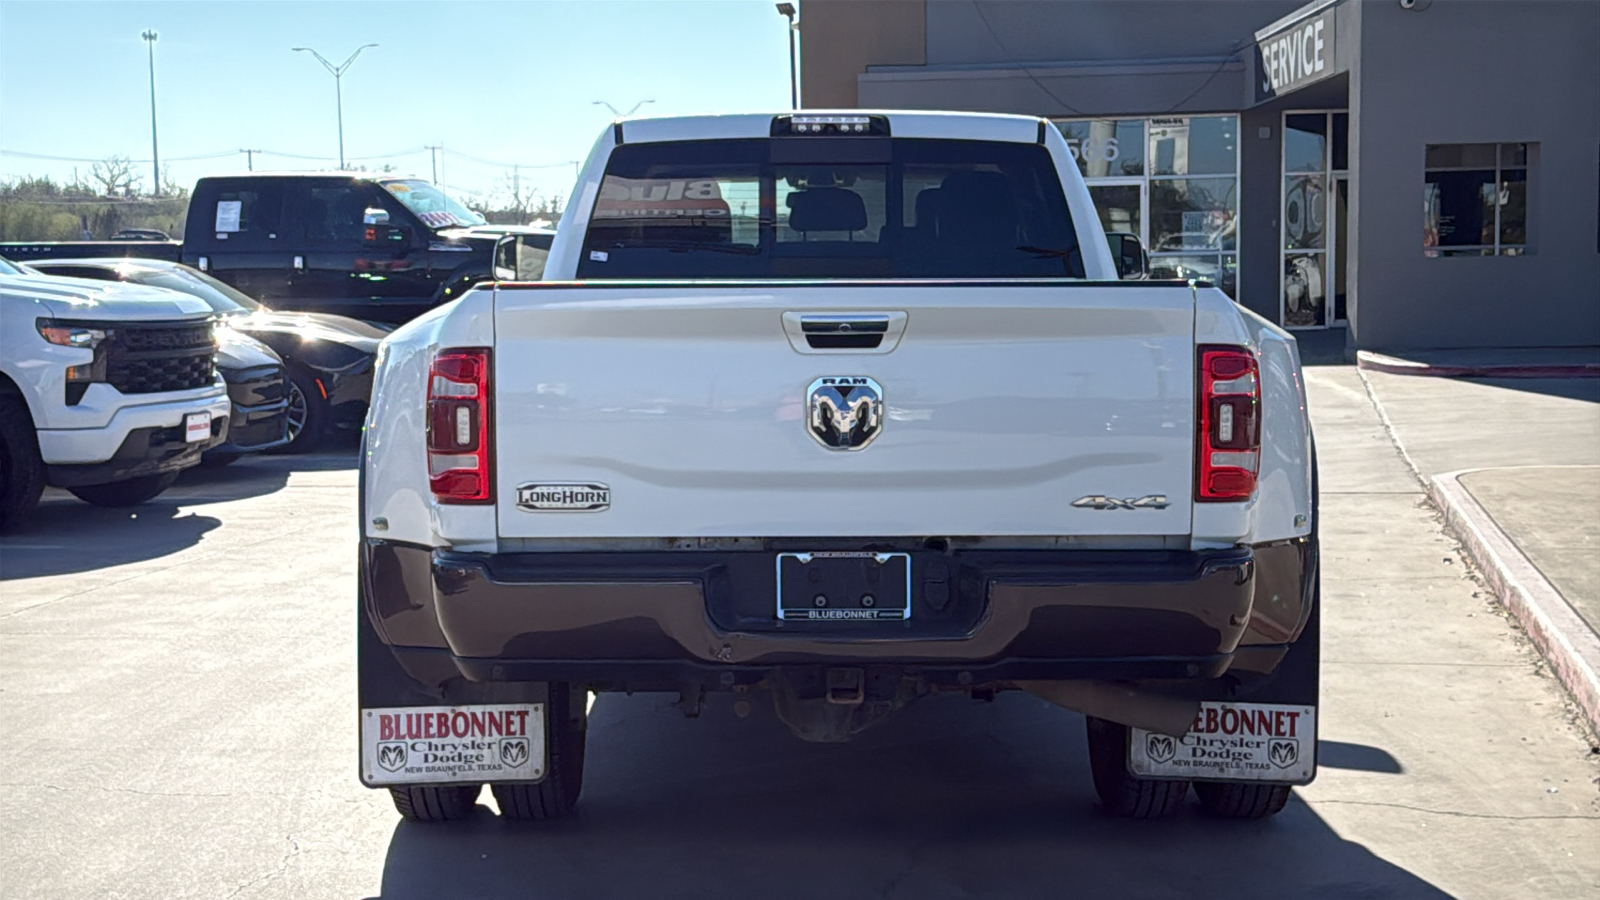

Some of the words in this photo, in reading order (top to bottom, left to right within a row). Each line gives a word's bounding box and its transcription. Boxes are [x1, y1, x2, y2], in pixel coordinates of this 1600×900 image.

[1262, 19, 1324, 93] SERVICE
[518, 490, 607, 504] LONGHORN
[808, 610, 879, 619] BLUEBONNET
[379, 710, 530, 741] BLUEBONNET
[1189, 706, 1300, 738] EBONNET
[410, 740, 497, 753] Chrysler
[1179, 735, 1266, 749] Chrysler
[423, 751, 486, 764] Dodge
[1191, 747, 1253, 761] Dodge
[425, 764, 475, 773] BRAUNFELS,
[477, 763, 503, 771] TEXAS
[1244, 762, 1270, 770] TEXAS
